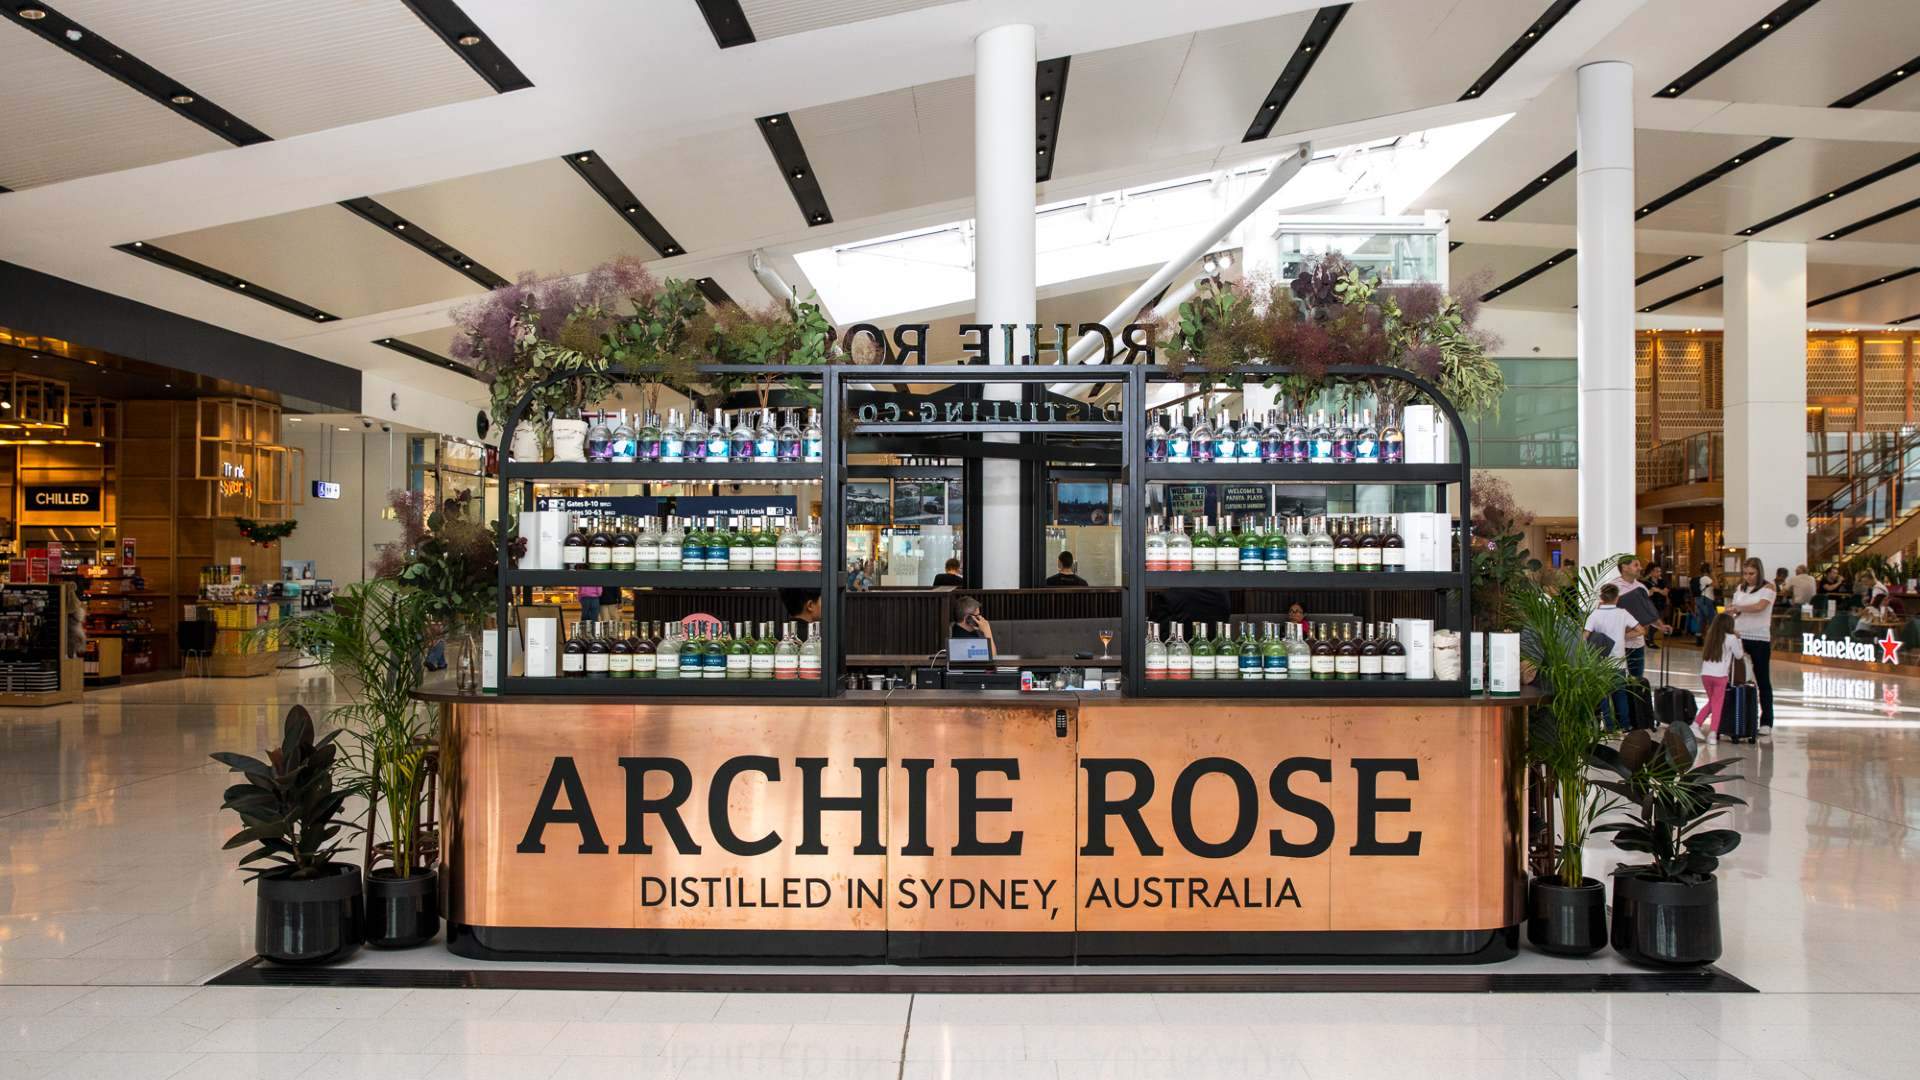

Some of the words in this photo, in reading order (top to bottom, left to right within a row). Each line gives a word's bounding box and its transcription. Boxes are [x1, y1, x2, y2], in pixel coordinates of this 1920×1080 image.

[35, 493, 90, 505] CHILLED
[730, 507, 750, 515] Transit
[1802, 632, 1876, 662] Heineken
[516, 754, 1024, 857] ARCHIE
[1079, 756, 1423, 859] ROSE
[641, 876, 832, 908] DISTILLED
[847, 878, 883, 909] IN
[899, 878, 1058, 920] SYDNEY,
[1085, 877, 1302, 909] AUSTRALIA
